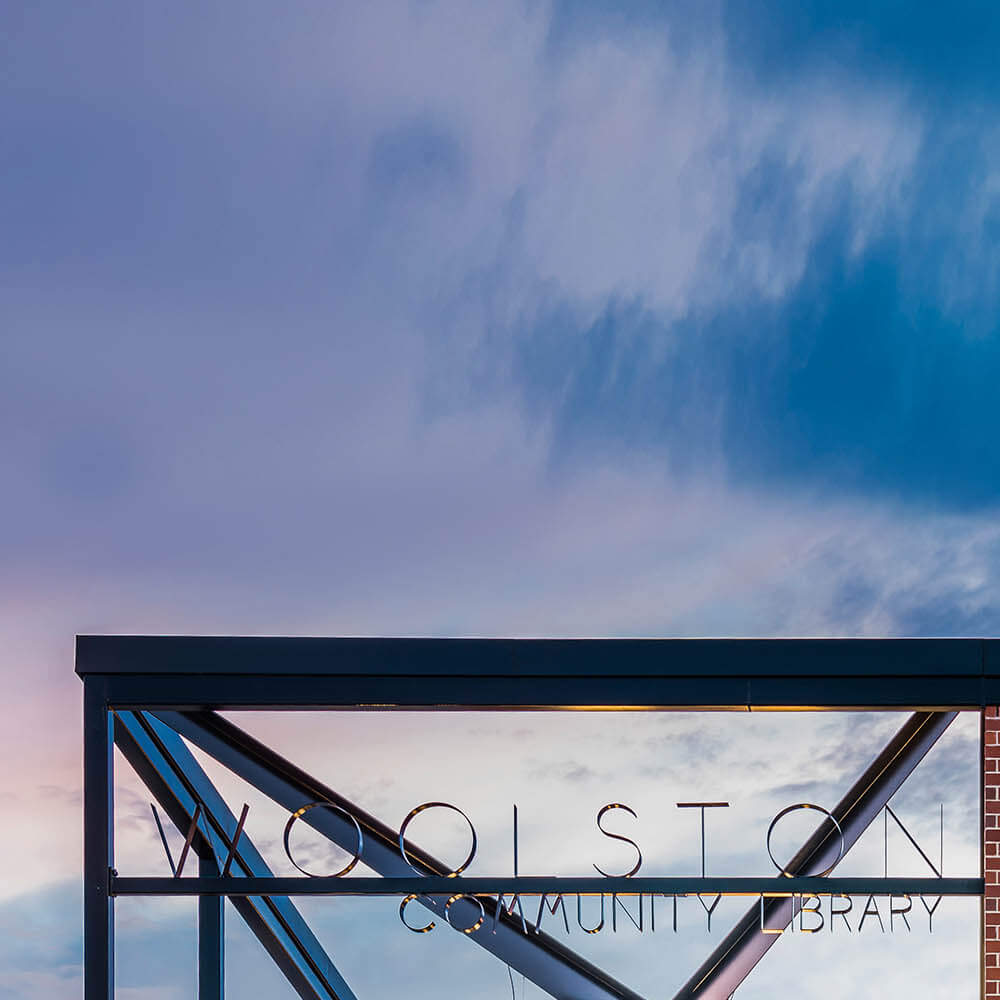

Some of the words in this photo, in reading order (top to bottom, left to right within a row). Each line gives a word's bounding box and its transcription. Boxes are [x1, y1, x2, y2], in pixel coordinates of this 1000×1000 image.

[150, 802, 943, 879] WOOLSTON
[400, 893, 722, 935] COMMUNITY
[760, 893, 943, 934] LIBRARY
